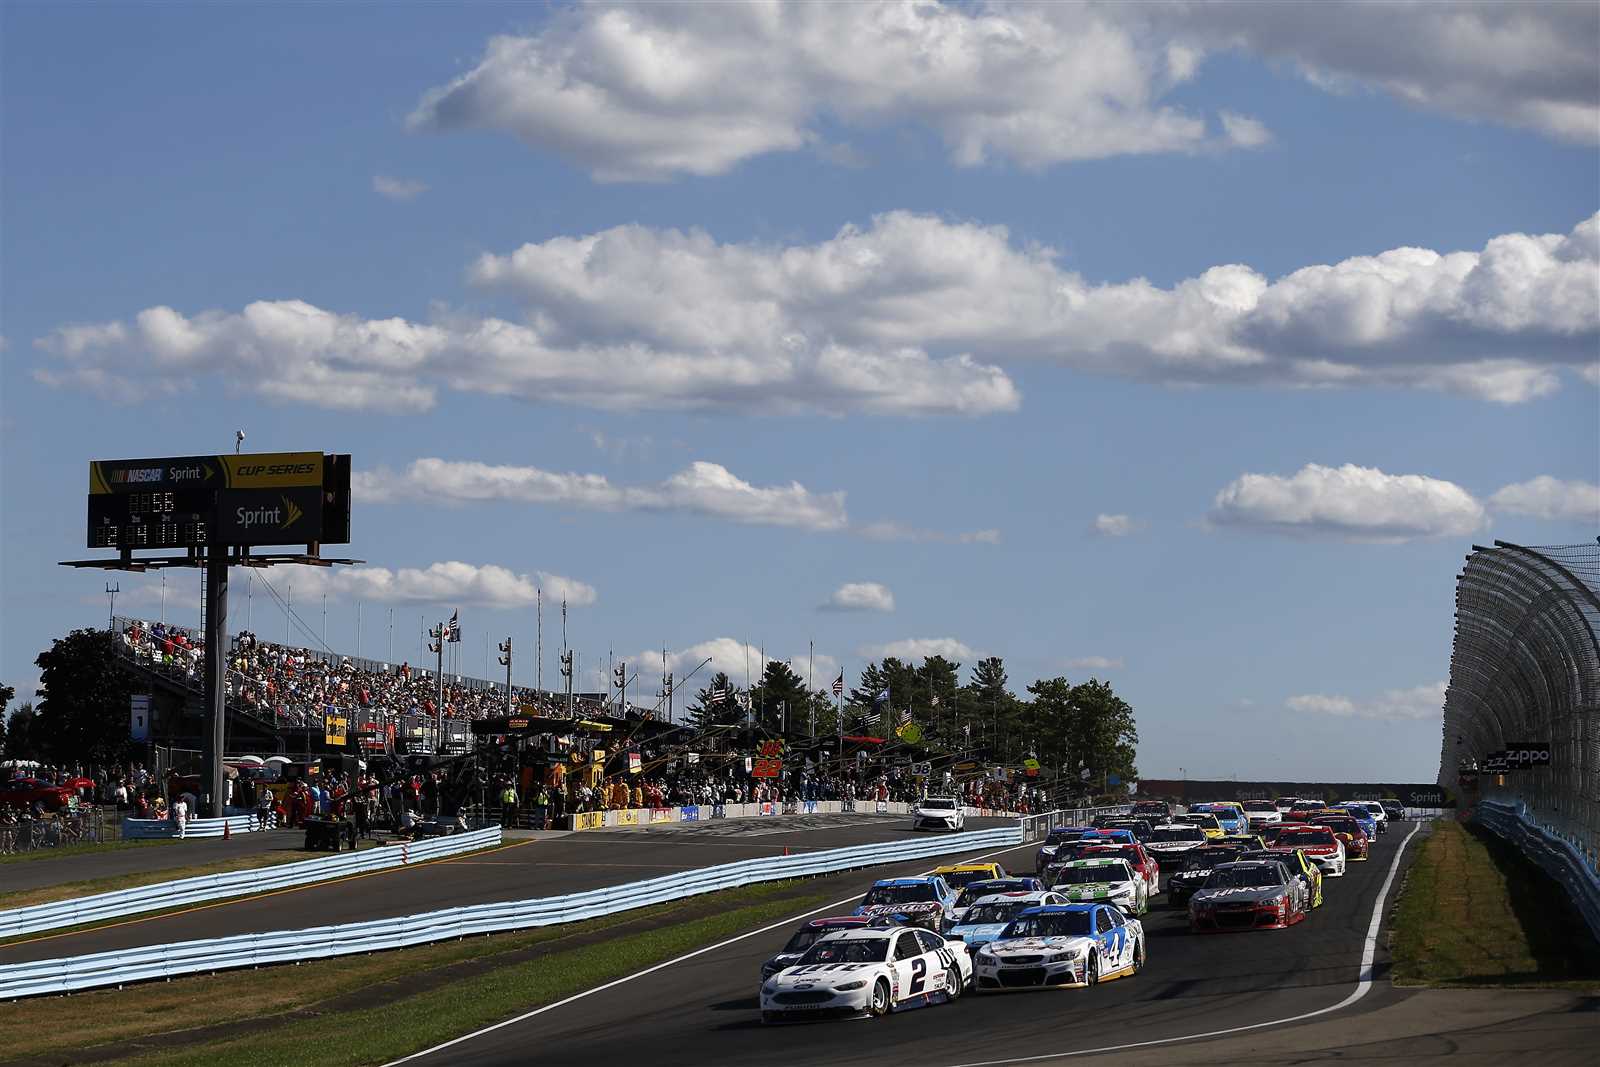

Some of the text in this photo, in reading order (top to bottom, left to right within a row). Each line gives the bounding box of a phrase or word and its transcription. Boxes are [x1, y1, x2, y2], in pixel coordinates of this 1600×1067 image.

[128, 463, 315, 483] NASCAR Sprint CUP SERIES
[236, 506, 280, 528] Sprint
[752, 759, 783, 778] 22
[1409, 791, 1441, 803] Sprint
[1108, 932, 1121, 968] 4
[909, 957, 926, 996] 2
